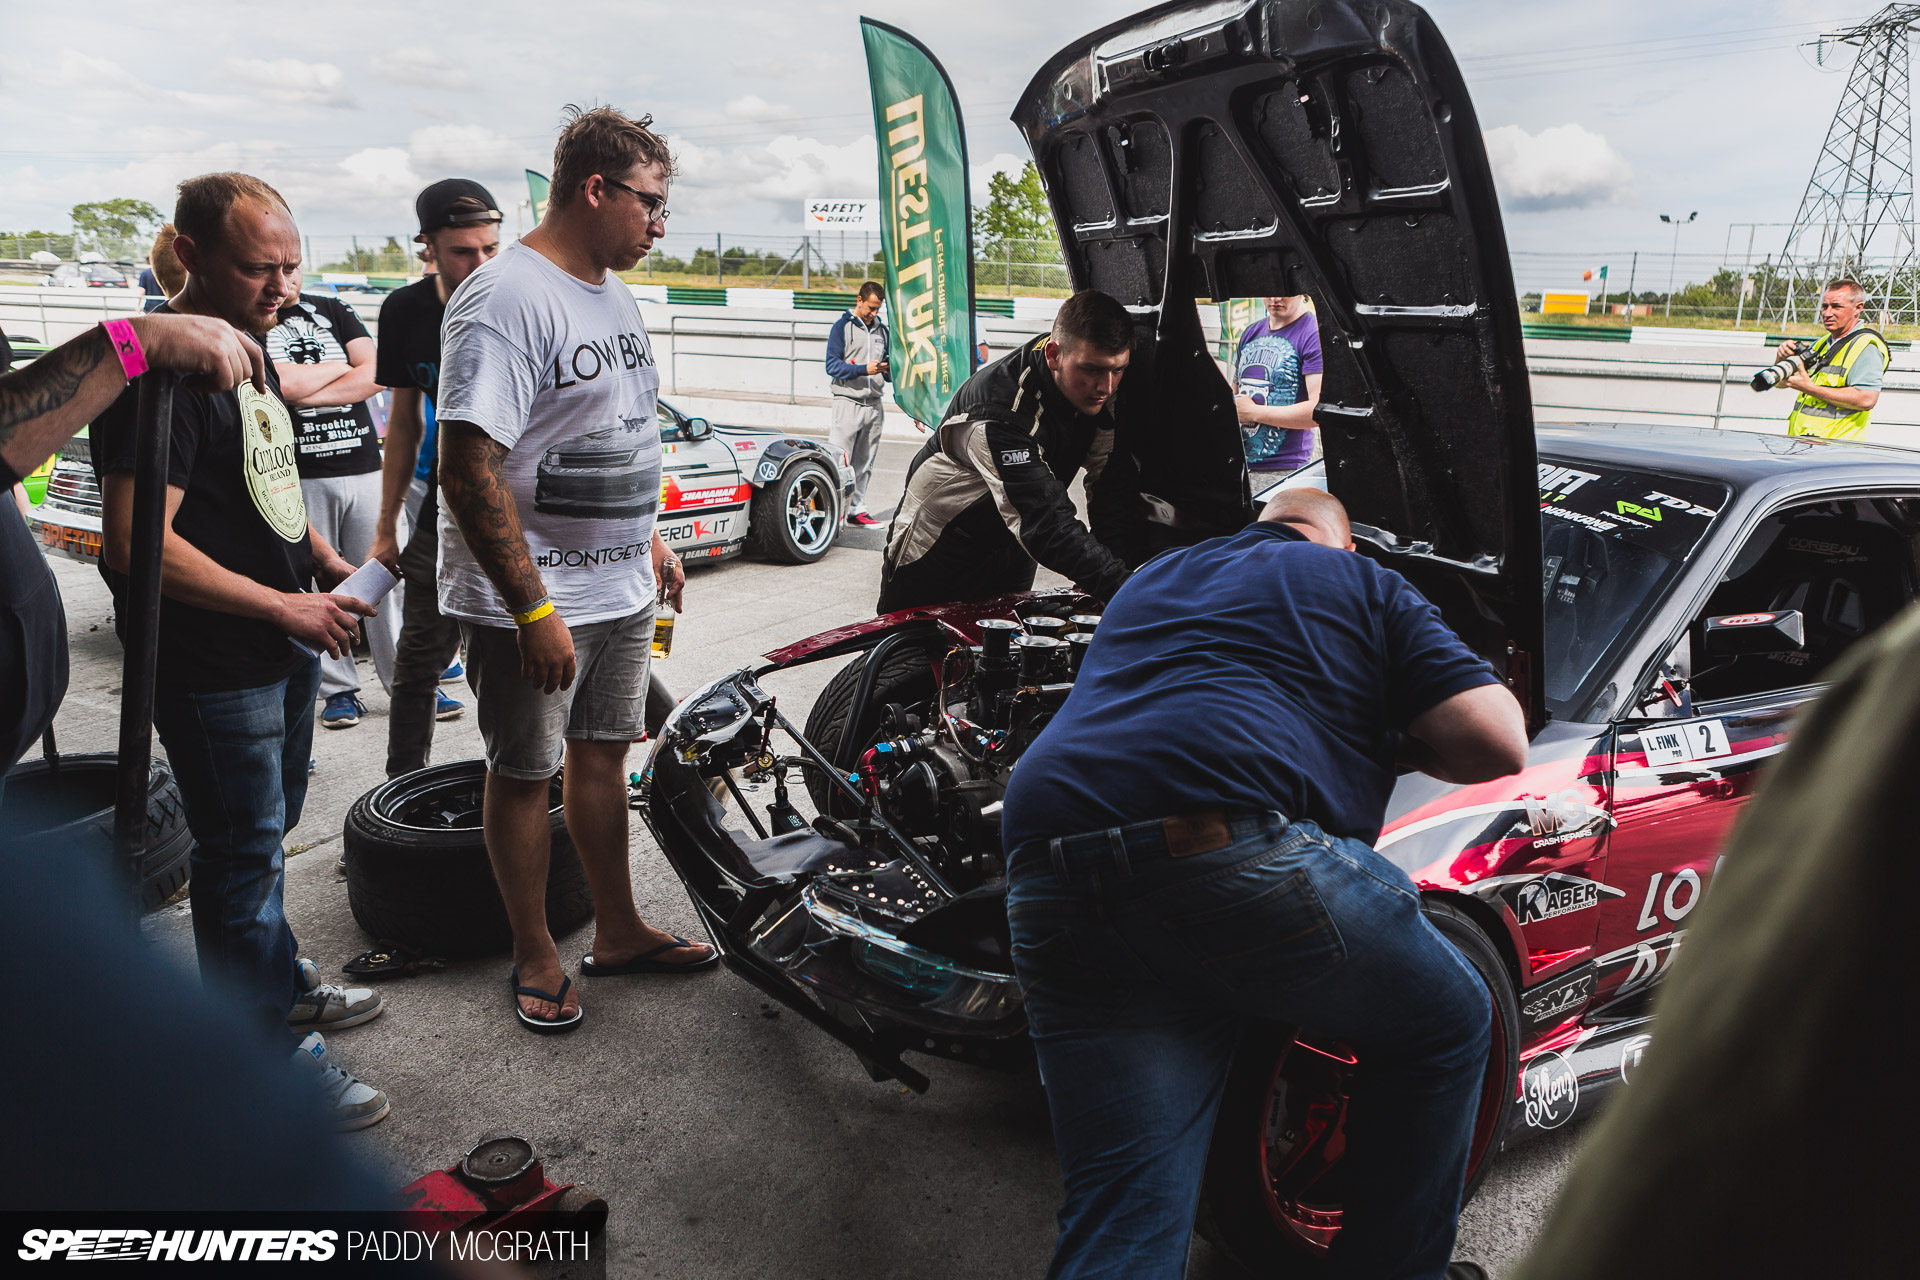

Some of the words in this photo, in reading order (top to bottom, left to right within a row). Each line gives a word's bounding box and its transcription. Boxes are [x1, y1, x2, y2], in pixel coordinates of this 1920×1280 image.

[810, 203, 868, 213] SAFETY
[826, 215, 863, 223] DIRECT
[301, 418, 358, 434] Brooklyn
[1001, 450, 1031, 464] OMP
[680, 487, 737, 502] SHANAHAN
[1643, 490, 1718, 518] TDP
[1540, 505, 1619, 531] NANKANG
[1599, 510, 1653, 529] PRODRIFT
[658, 517, 730, 542] EROKIT
[536, 540, 652, 568] #DONTGETO
[1787, 536, 1860, 556] CORBEAU
[1727, 616, 1762, 625] HEL
[1656, 734, 1680, 749] FINK
[1699, 725, 1716, 753] 2
[1522, 788, 1592, 837] MG
[1532, 835, 1560, 850] CRASH
[1559, 829, 1593, 844] REPAIRS
[1518, 879, 1598, 925] KABER
[1543, 900, 1597, 918] PERFORMANCE
